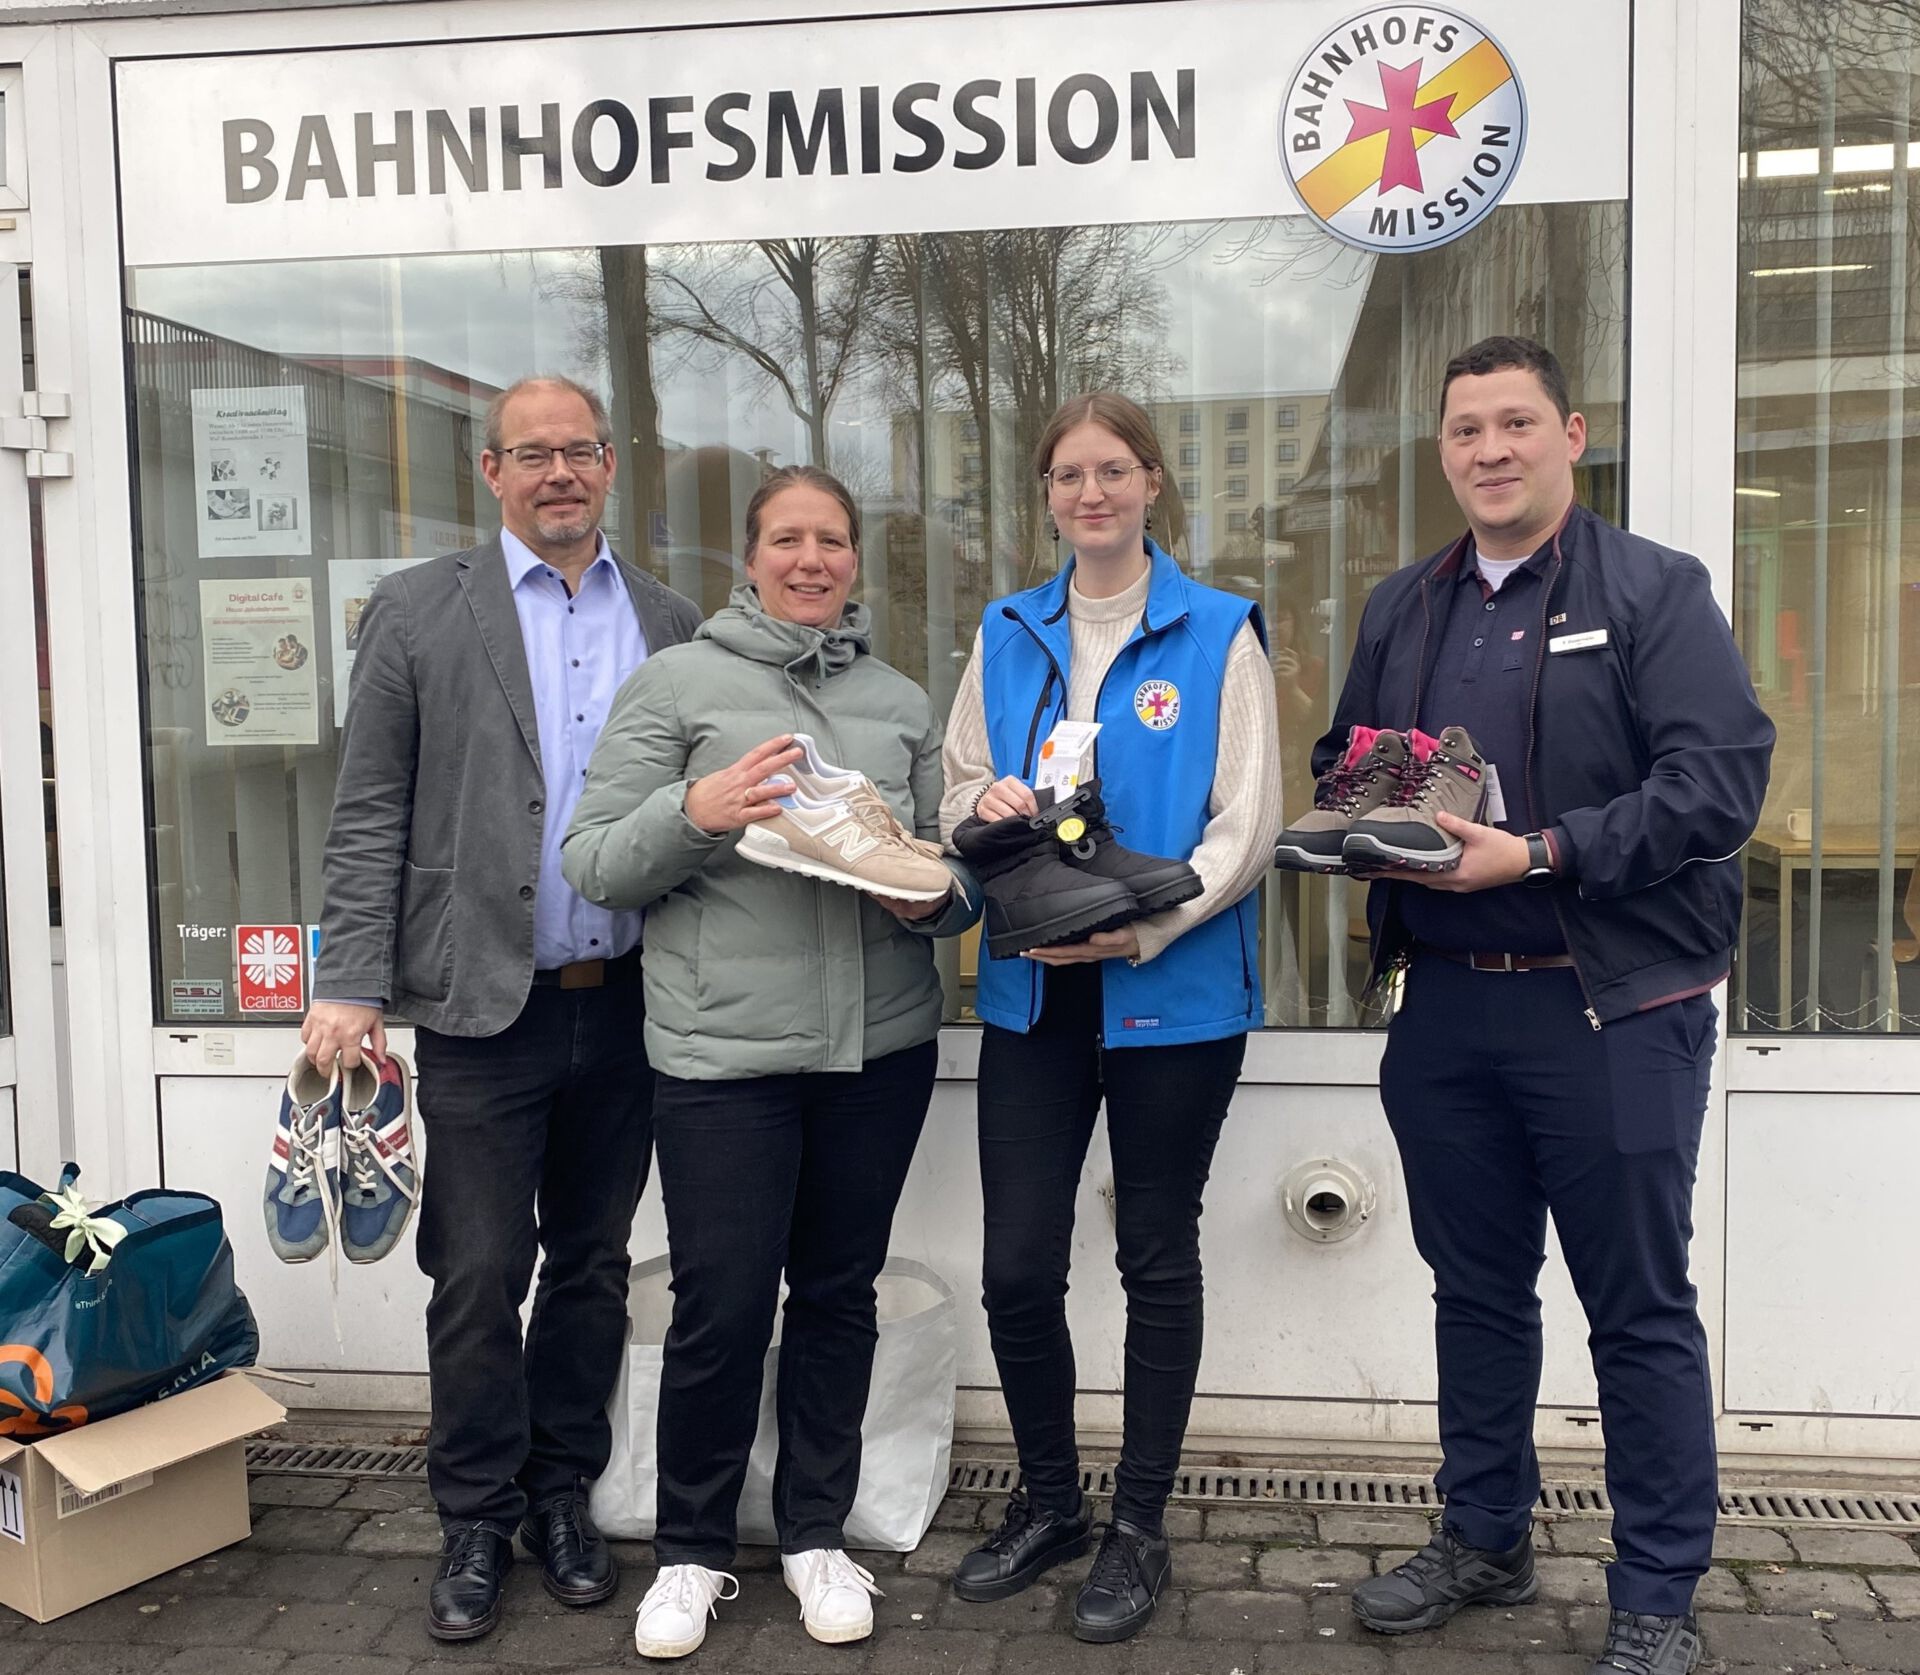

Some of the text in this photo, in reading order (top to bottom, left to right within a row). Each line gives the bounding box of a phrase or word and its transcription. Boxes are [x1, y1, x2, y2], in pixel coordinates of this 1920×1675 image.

[1293, 16, 1459, 153] BAHNHOFS
[221, 68, 1197, 205] BAHNHOFSMISSION
[1367, 123, 1512, 239] MISSION
[229, 592, 260, 604] Digital
[1136, 683, 1169, 708] BAHNHOFS
[1152, 702, 1179, 727] MISSION
[176, 923, 228, 941] Träger:
[245, 993, 297, 1009] caritas
